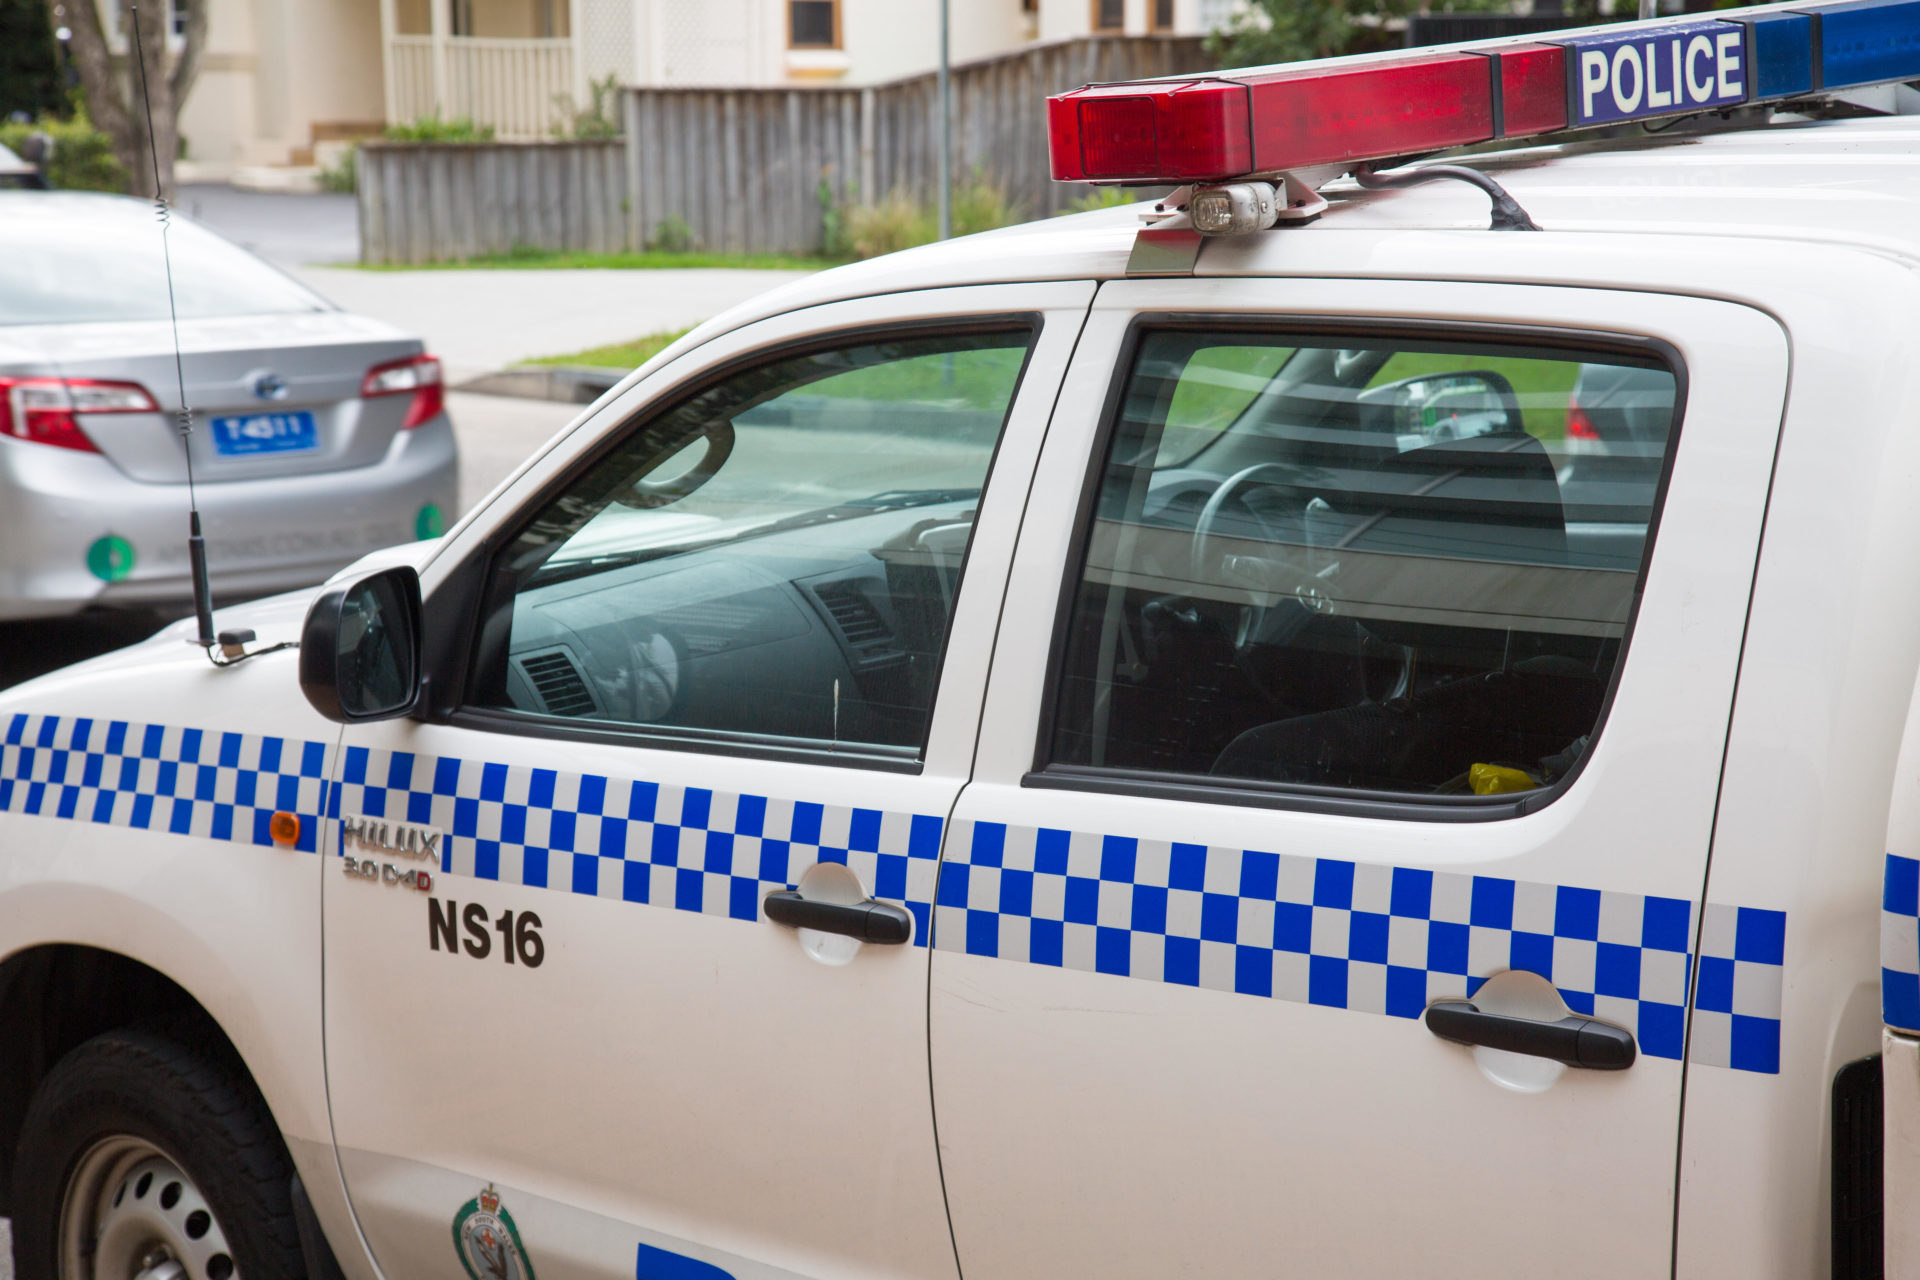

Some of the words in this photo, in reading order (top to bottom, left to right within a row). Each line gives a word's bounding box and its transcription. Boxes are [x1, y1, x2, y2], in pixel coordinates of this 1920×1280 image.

[1581, 31, 1743, 118] POLICE
[344, 816, 440, 862] HILUX
[428, 897, 545, 969] NS16
